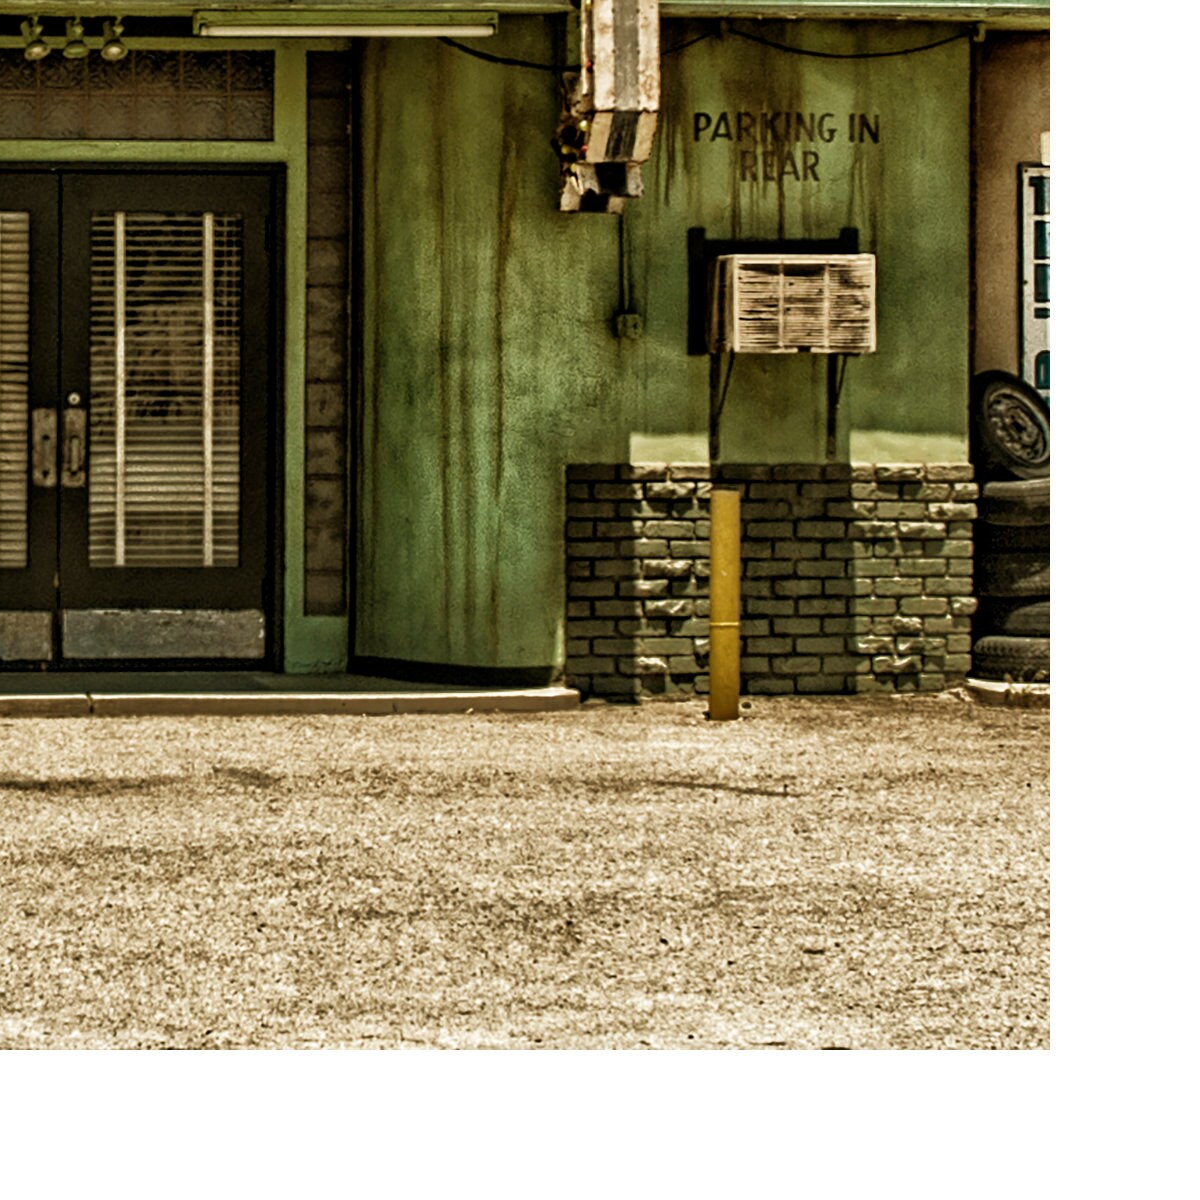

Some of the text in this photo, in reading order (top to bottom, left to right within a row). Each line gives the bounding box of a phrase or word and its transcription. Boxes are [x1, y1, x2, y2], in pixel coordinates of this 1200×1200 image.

[693, 111, 880, 144] PARKING IN
[739, 150, 820, 182] REAR
